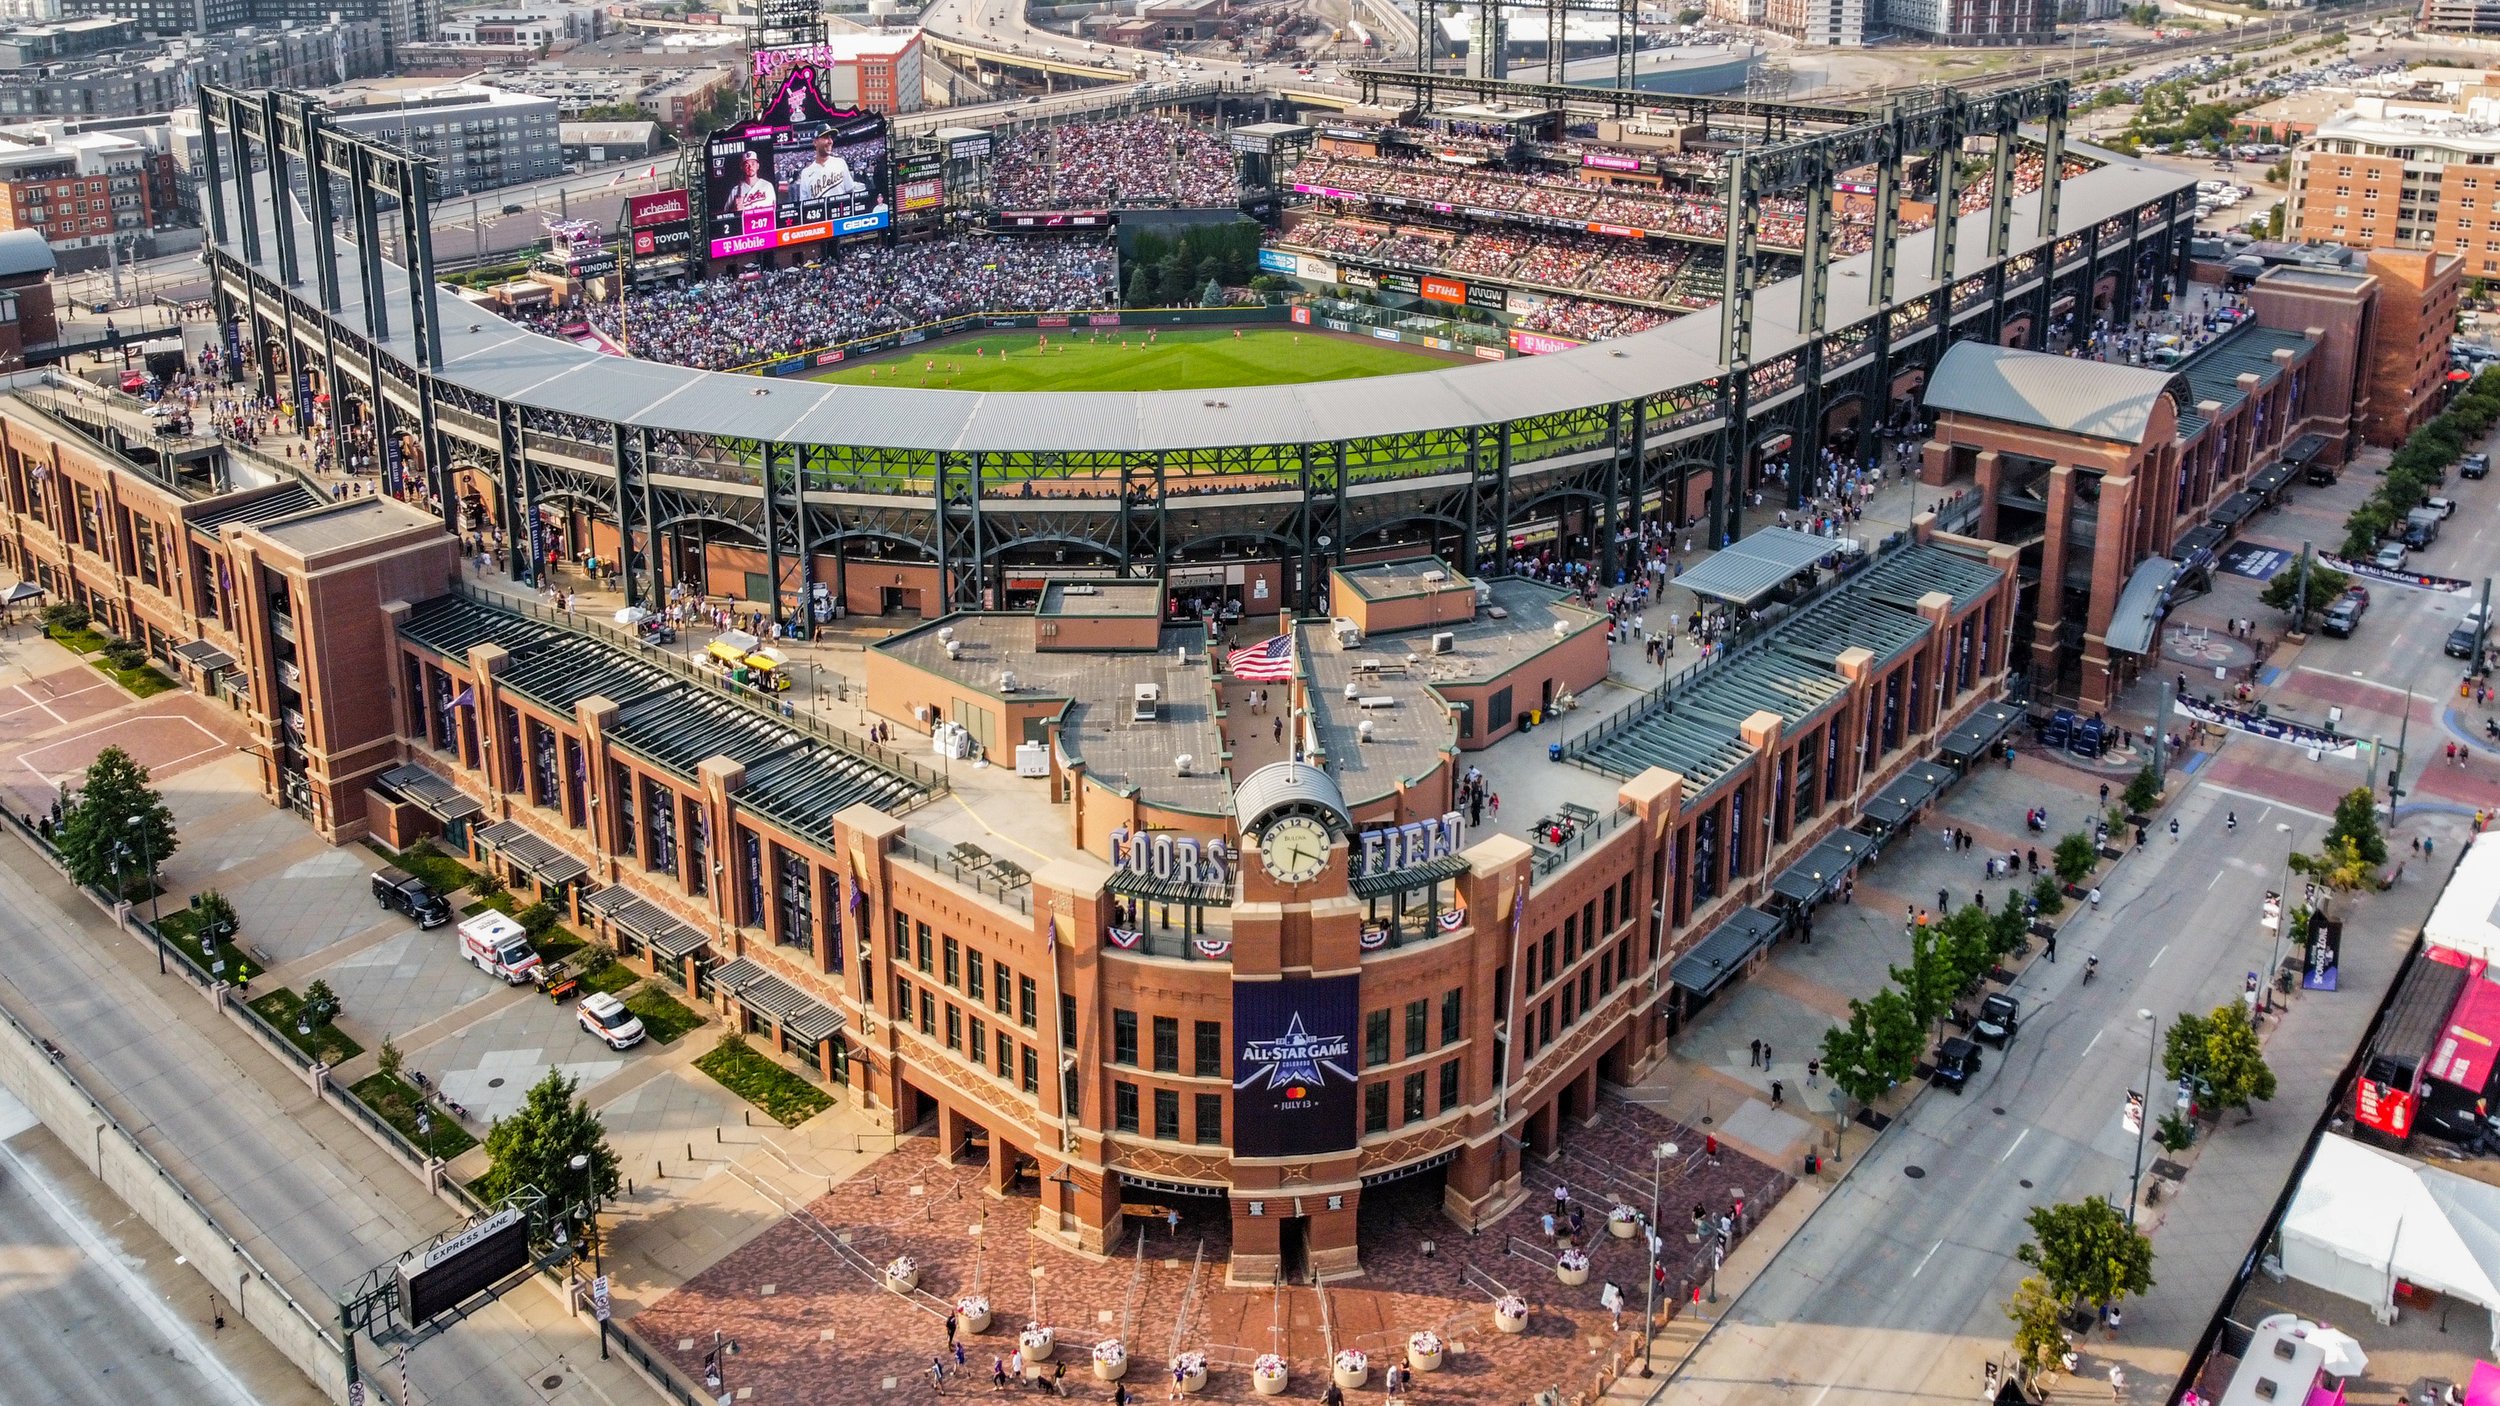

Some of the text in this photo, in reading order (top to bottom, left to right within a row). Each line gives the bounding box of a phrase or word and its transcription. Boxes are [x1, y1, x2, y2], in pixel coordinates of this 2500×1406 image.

[752, 45, 835, 76] ROCKIES
[712, 141, 745, 156] MANCINI
[908, 169, 940, 178] SPORTSBOOK
[904, 183, 935, 198] KING
[639, 199, 681, 216] uchealth
[724, 224, 730, 234] 2
[750, 218, 768, 230] 2:07
[843, 216, 879, 231] GEICO
[654, 231, 690, 245] TOYOTA
[791, 227, 826, 239] GATORADE
[733, 236, 766, 251] Mobile
[580, 261, 614, 274] TUNDRA
[1345, 266, 1371, 277] Bank of
[1345, 275, 1377, 288] Colorado
[1427, 284, 1459, 297] STIHL
[1468, 286, 1502, 300] ARROW
[1328, 319, 1348, 331] YETI
[819, 353, 841, 363] roman
[1479, 349, 1501, 358] roman
[1266, 833, 1275, 841] 10
[1360, 811, 1466, 877] FIELD
[1109, 827, 1228, 884] COORS
[2317, 927, 2328, 949] ZONE
[2313, 949, 2325, 984] SPONSOR
[1273, 1046, 1307, 1060] STAR
[1308, 1043, 1349, 1058] GAME
[1282, 1060, 1311, 1068] COLORADO
[1281, 1100, 1312, 1110] JULY 13
[1366, 1150, 1457, 1186] HOME PLATE
[1120, 1174, 1222, 1197] HOME PLATE
[433, 1215, 509, 1261] EXPRESS LANE
